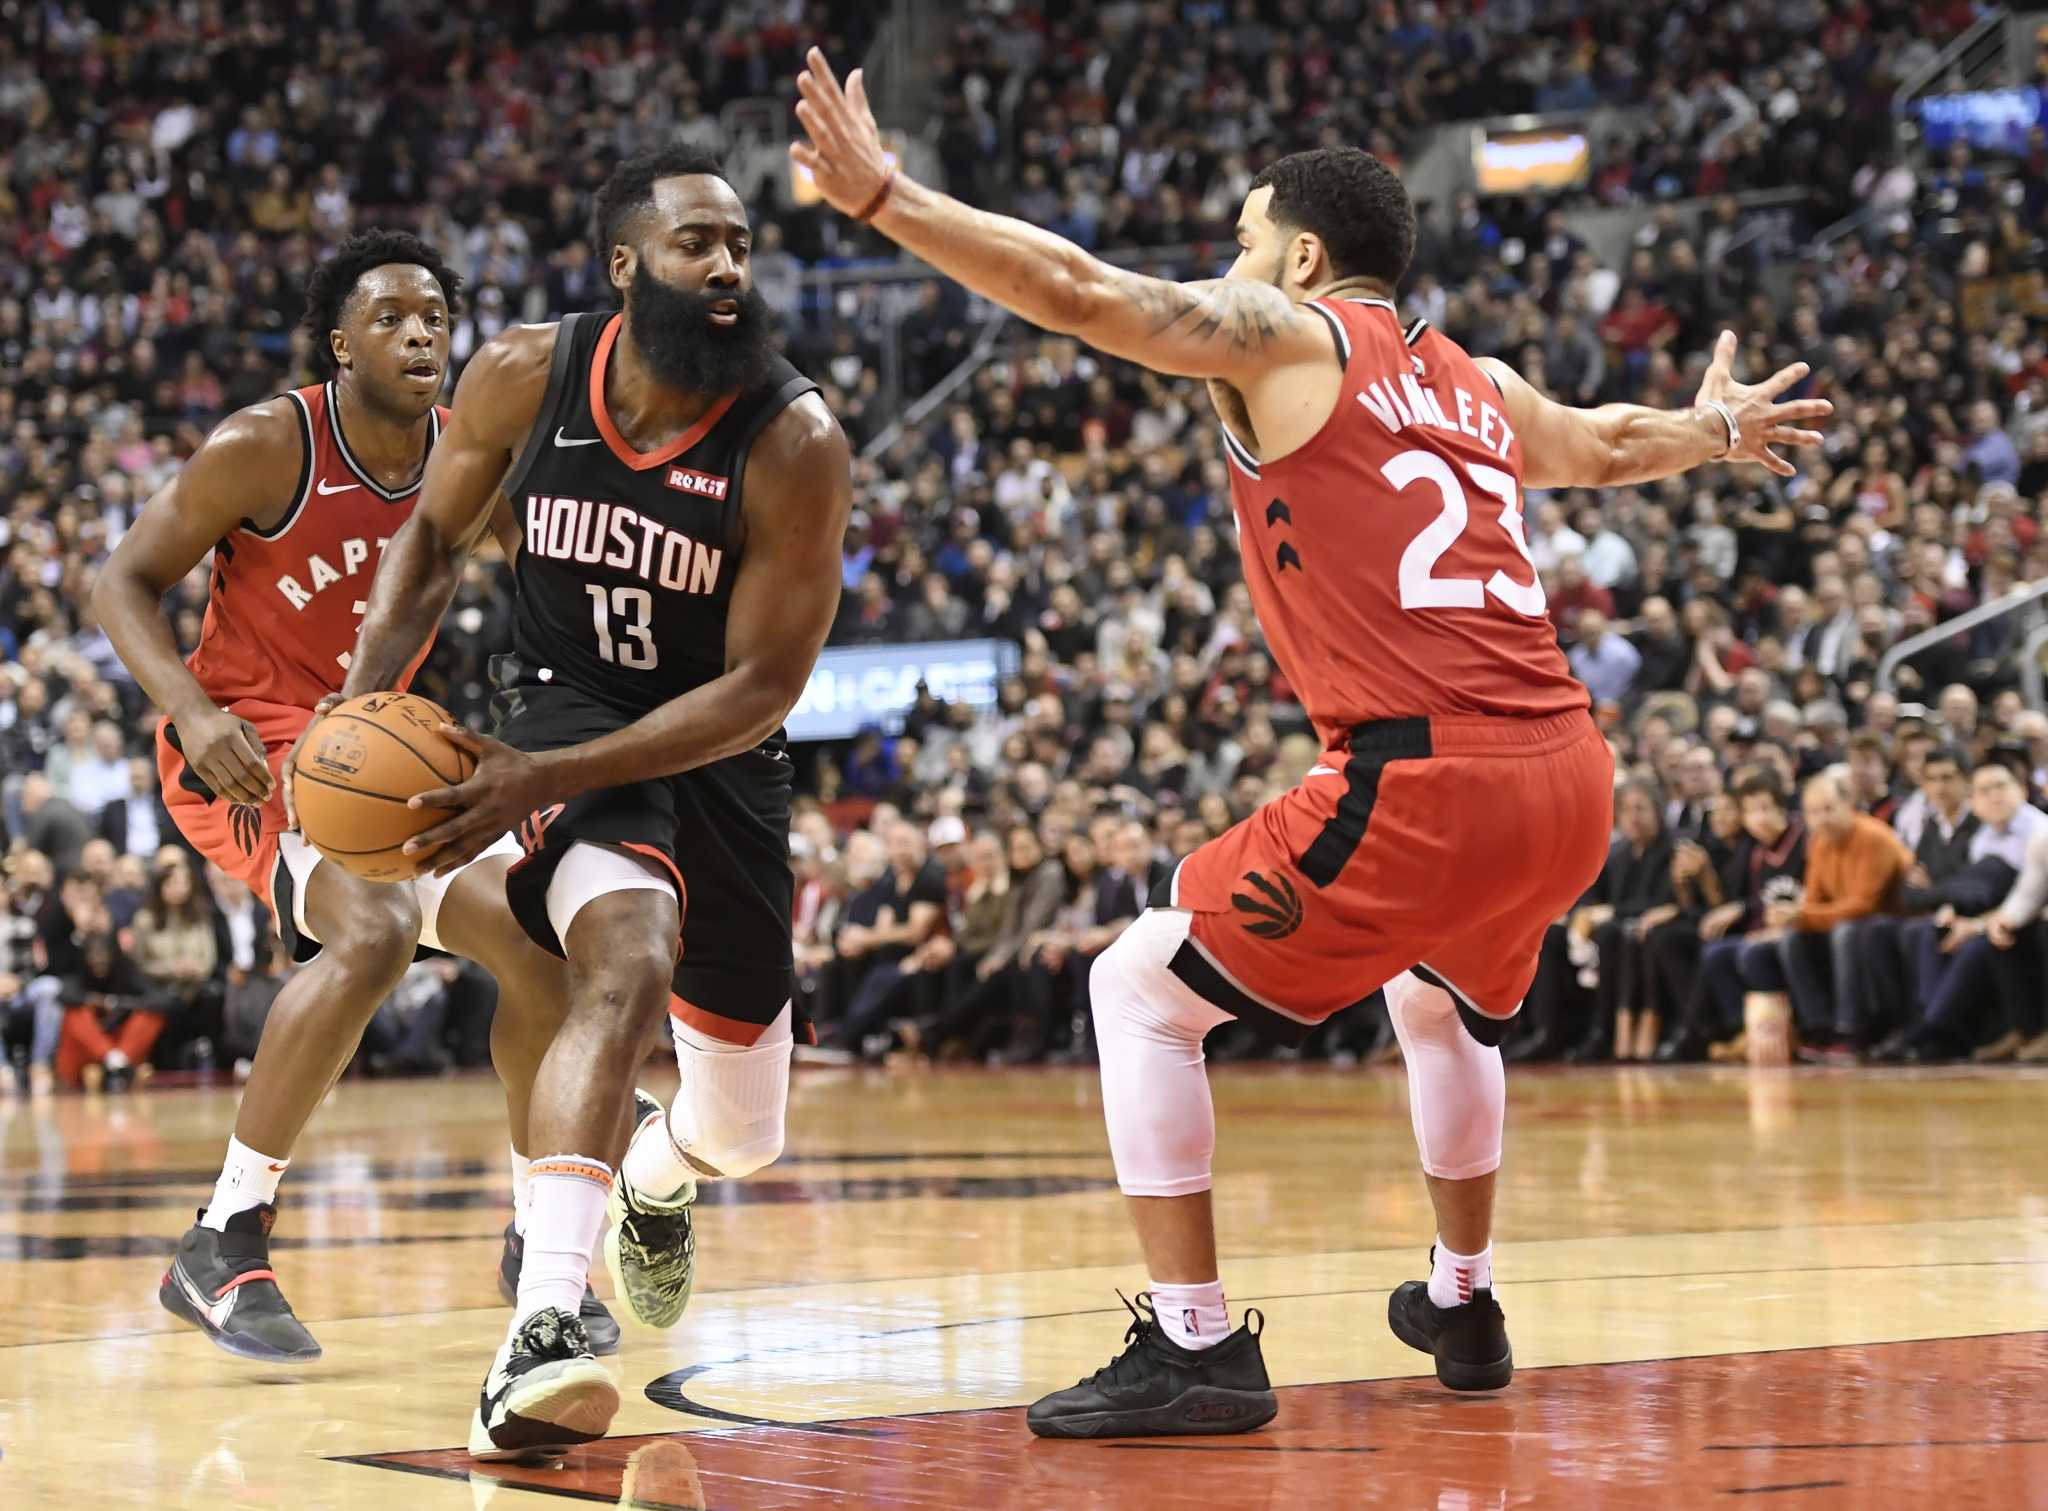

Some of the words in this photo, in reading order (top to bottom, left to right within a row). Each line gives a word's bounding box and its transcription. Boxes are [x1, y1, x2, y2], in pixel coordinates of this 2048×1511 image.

[527, 496, 722, 595] HOUSTON
[1380, 450, 1547, 617] 23
[585, 583, 658, 671] 13
